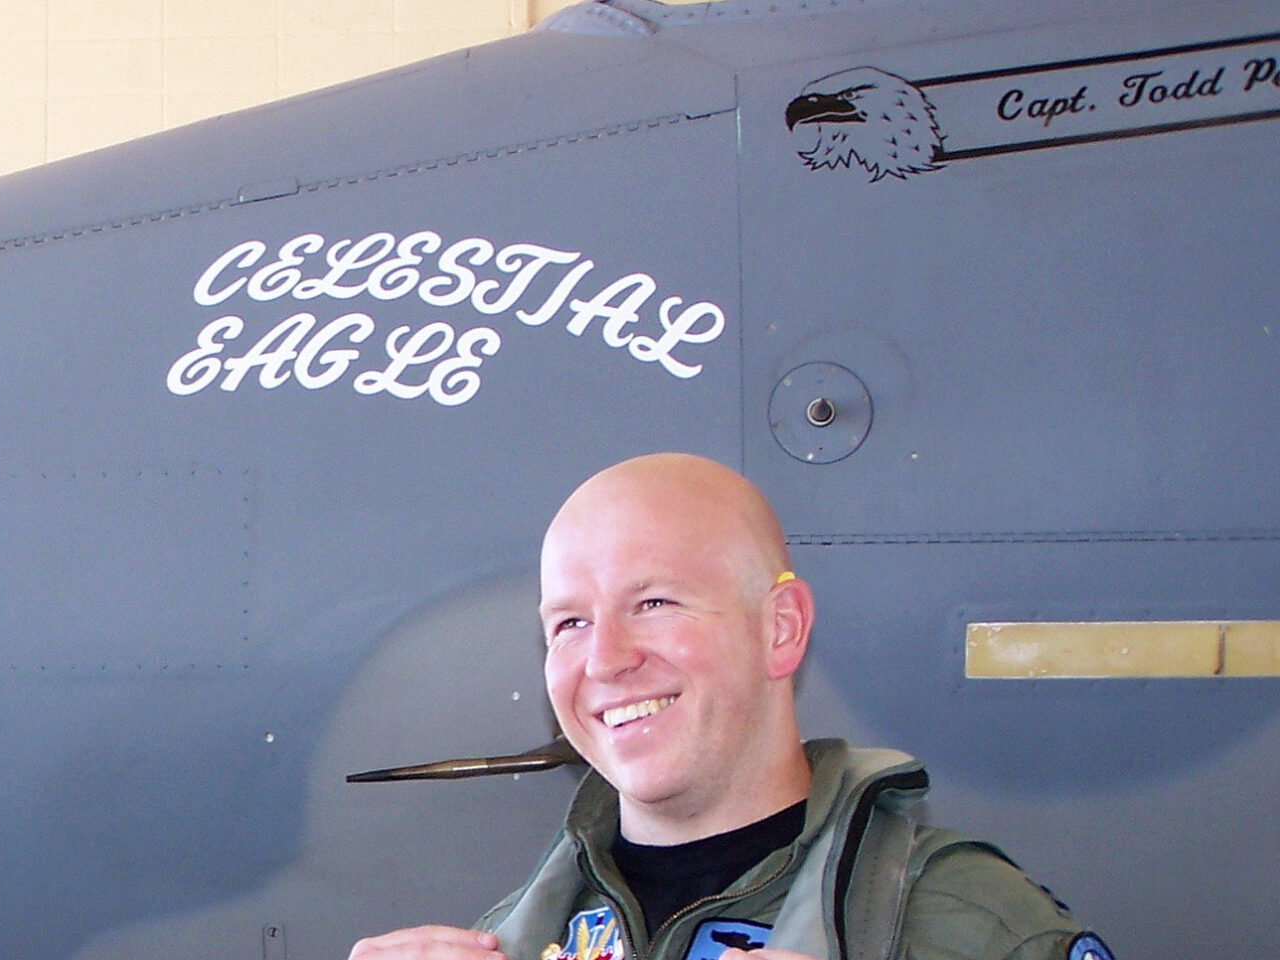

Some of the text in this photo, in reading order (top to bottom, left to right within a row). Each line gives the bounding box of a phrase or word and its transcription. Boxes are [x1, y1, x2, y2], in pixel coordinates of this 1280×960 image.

[997, 85, 1096, 127] Capt.
[1119, 66, 1226, 107] Todd
[193, 230, 726, 379] CELESTIAL
[166, 312, 502, 406] EAGLE
